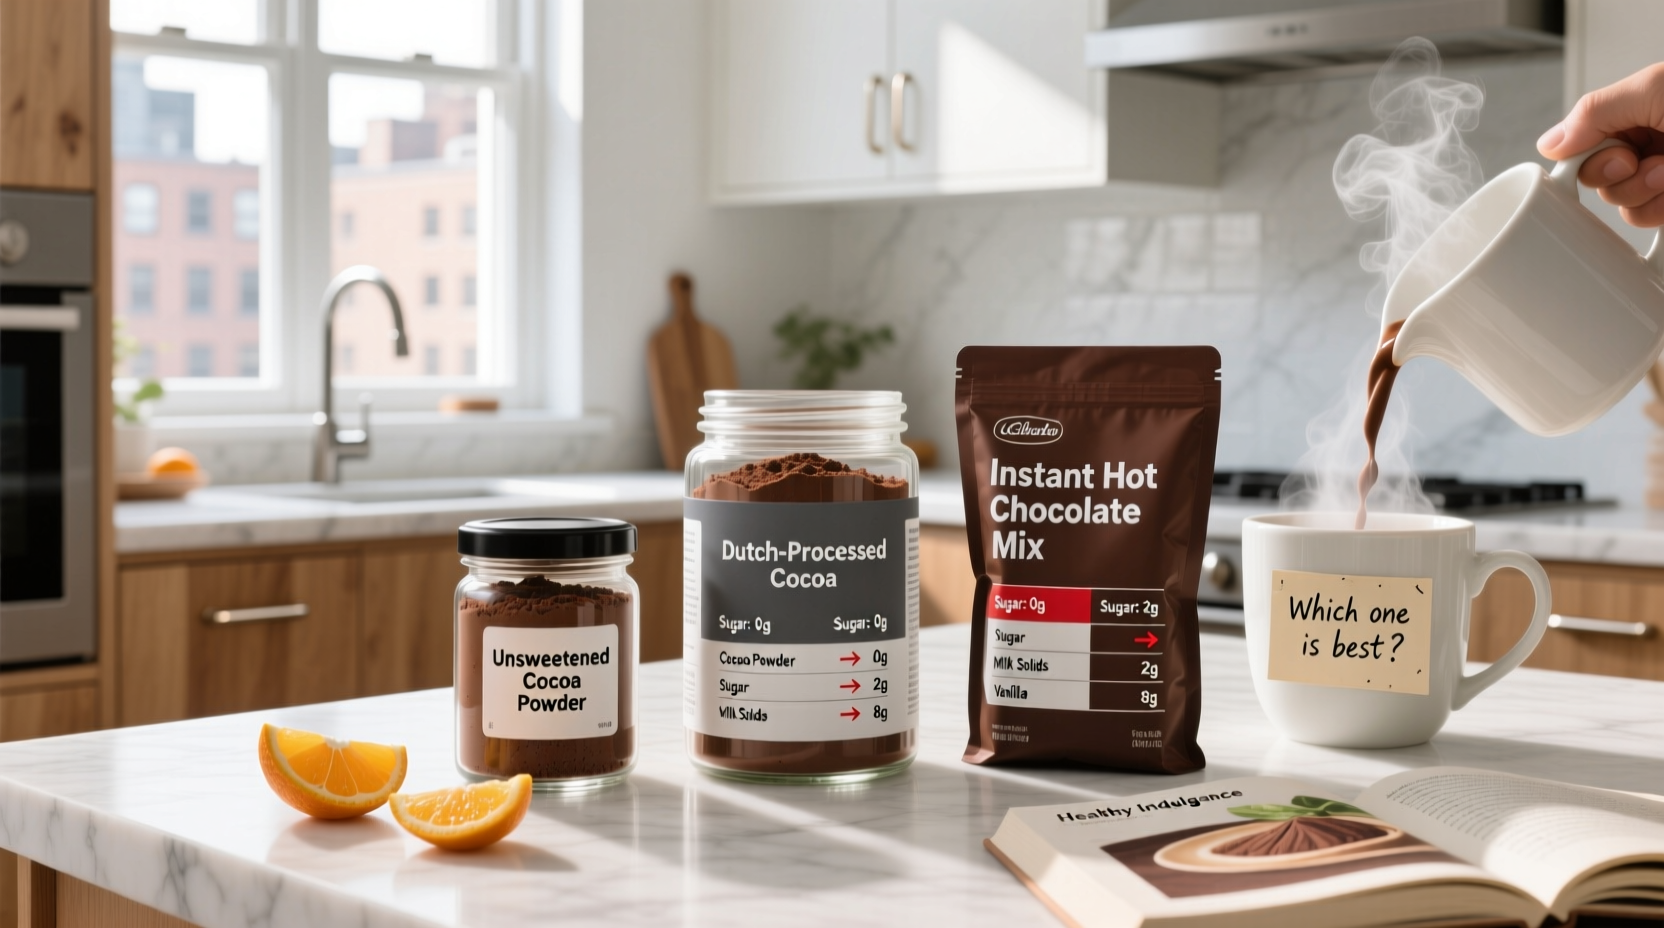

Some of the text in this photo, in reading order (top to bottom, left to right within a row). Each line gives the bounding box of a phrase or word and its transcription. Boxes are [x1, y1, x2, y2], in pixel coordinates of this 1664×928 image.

[990, 458, 1158, 489] Instant Hot
[990, 494, 1142, 524] Chocolate
[722, 538, 887, 562] Dutch-Processed
[992, 530, 1045, 561] Mix
[770, 568, 837, 588] Cocoa
[994, 595, 1046, 614] Sugar: 0g
[1100, 600, 1159, 617] Sugar: 2g
[1290, 592, 1410, 624] Which one
[754, 617, 771, 635] 0g
[873, 614, 888, 632] 0g
[995, 629, 1026, 646] Sugar
[1302, 633, 1320, 657] is
[493, 646, 610, 667] Unsweetened
[753, 653, 796, 667] Powder
[873, 649, 888, 666] 0g
[1016, 657, 1049, 672] Solids
[1140, 661, 1159, 679] 2g
[523, 672, 582, 690] Cocoa
[719, 677, 888, 696] Sugar 2g
[517, 694, 587, 711] Powder
[1140, 690, 1158, 708] 8g
[873, 705, 888, 722] 8g
